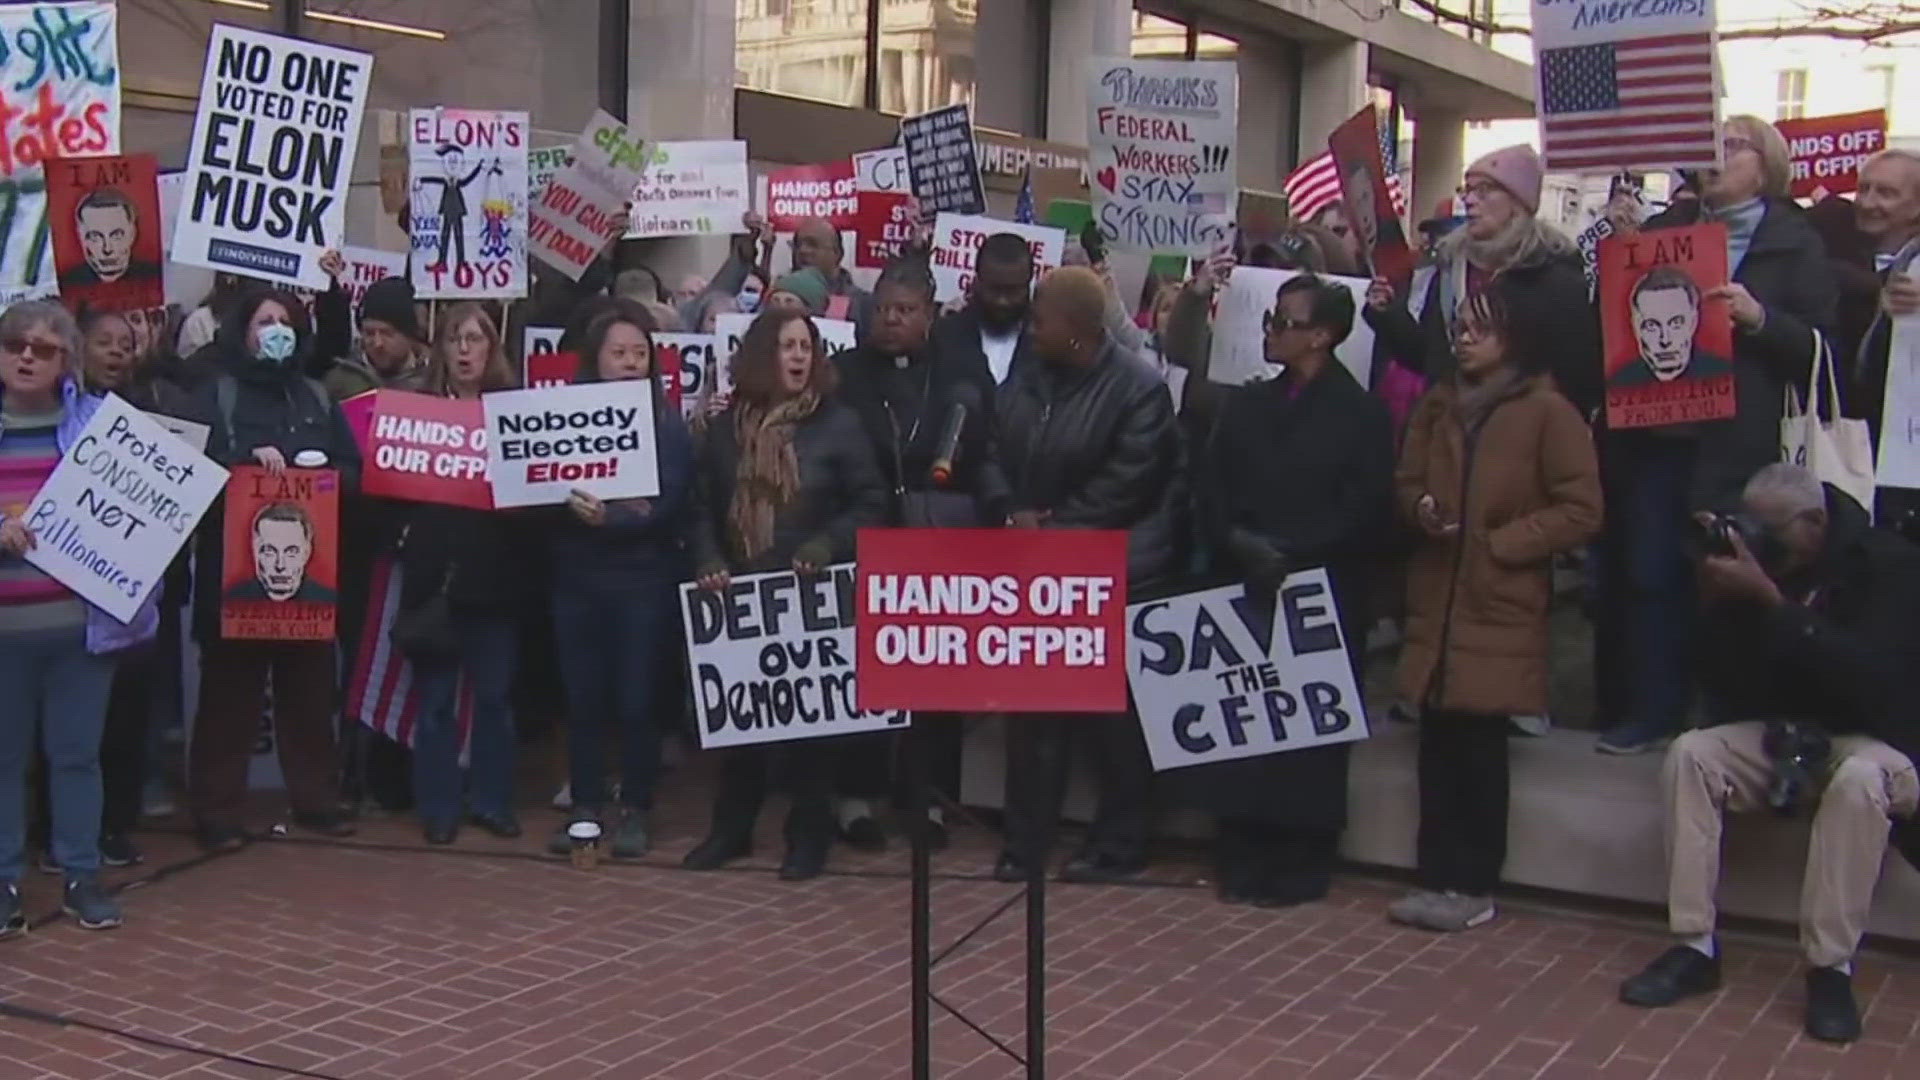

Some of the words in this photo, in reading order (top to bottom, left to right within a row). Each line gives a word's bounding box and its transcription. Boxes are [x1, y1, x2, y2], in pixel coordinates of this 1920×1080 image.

[217, 38, 271, 84] NO
[282, 52, 359, 103] ONE
[215, 82, 294, 121] VOTED
[300, 101, 348, 132] FOR
[415, 117, 520, 148] ELON'S
[1097, 106, 1195, 143] FEDERAL
[202, 111, 343, 190] ELON
[1790, 135, 1834, 158] NDS
[1838, 129, 1880, 152] OFF
[96, 162, 131, 186] AM
[772, 180, 830, 198] HANDS
[1122, 175, 1195, 203] STAY
[191, 172, 334, 247] MUSK
[774, 198, 811, 216] OUR
[950, 229, 987, 250] STO
[1624, 243, 1640, 269] I
[1652, 235, 1694, 265] AM
[424, 259, 512, 291] TOYS
[376, 415, 464, 449] HANDS
[498, 406, 637, 435] Nobody
[106, 415, 194, 485] Protect
[376, 445, 430, 473] OUR
[501, 431, 639, 461] Elected
[73, 435, 192, 534] CONSUMERS
[250, 474, 265, 498] I
[275, 475, 311, 500] AM
[526, 457, 618, 484] Elon!
[28, 499, 143, 598] Billionaires
[868, 575, 1016, 616] HANDS
[1028, 576, 1113, 617] OFF
[875, 626, 967, 665] OUR
[976, 627, 1106, 666] CFPB!
[1132, 583, 1342, 676] SAVE
[759, 637, 849, 677] OUR
[1216, 662, 1281, 695] THE
[1172, 681, 1350, 754] CFPB
